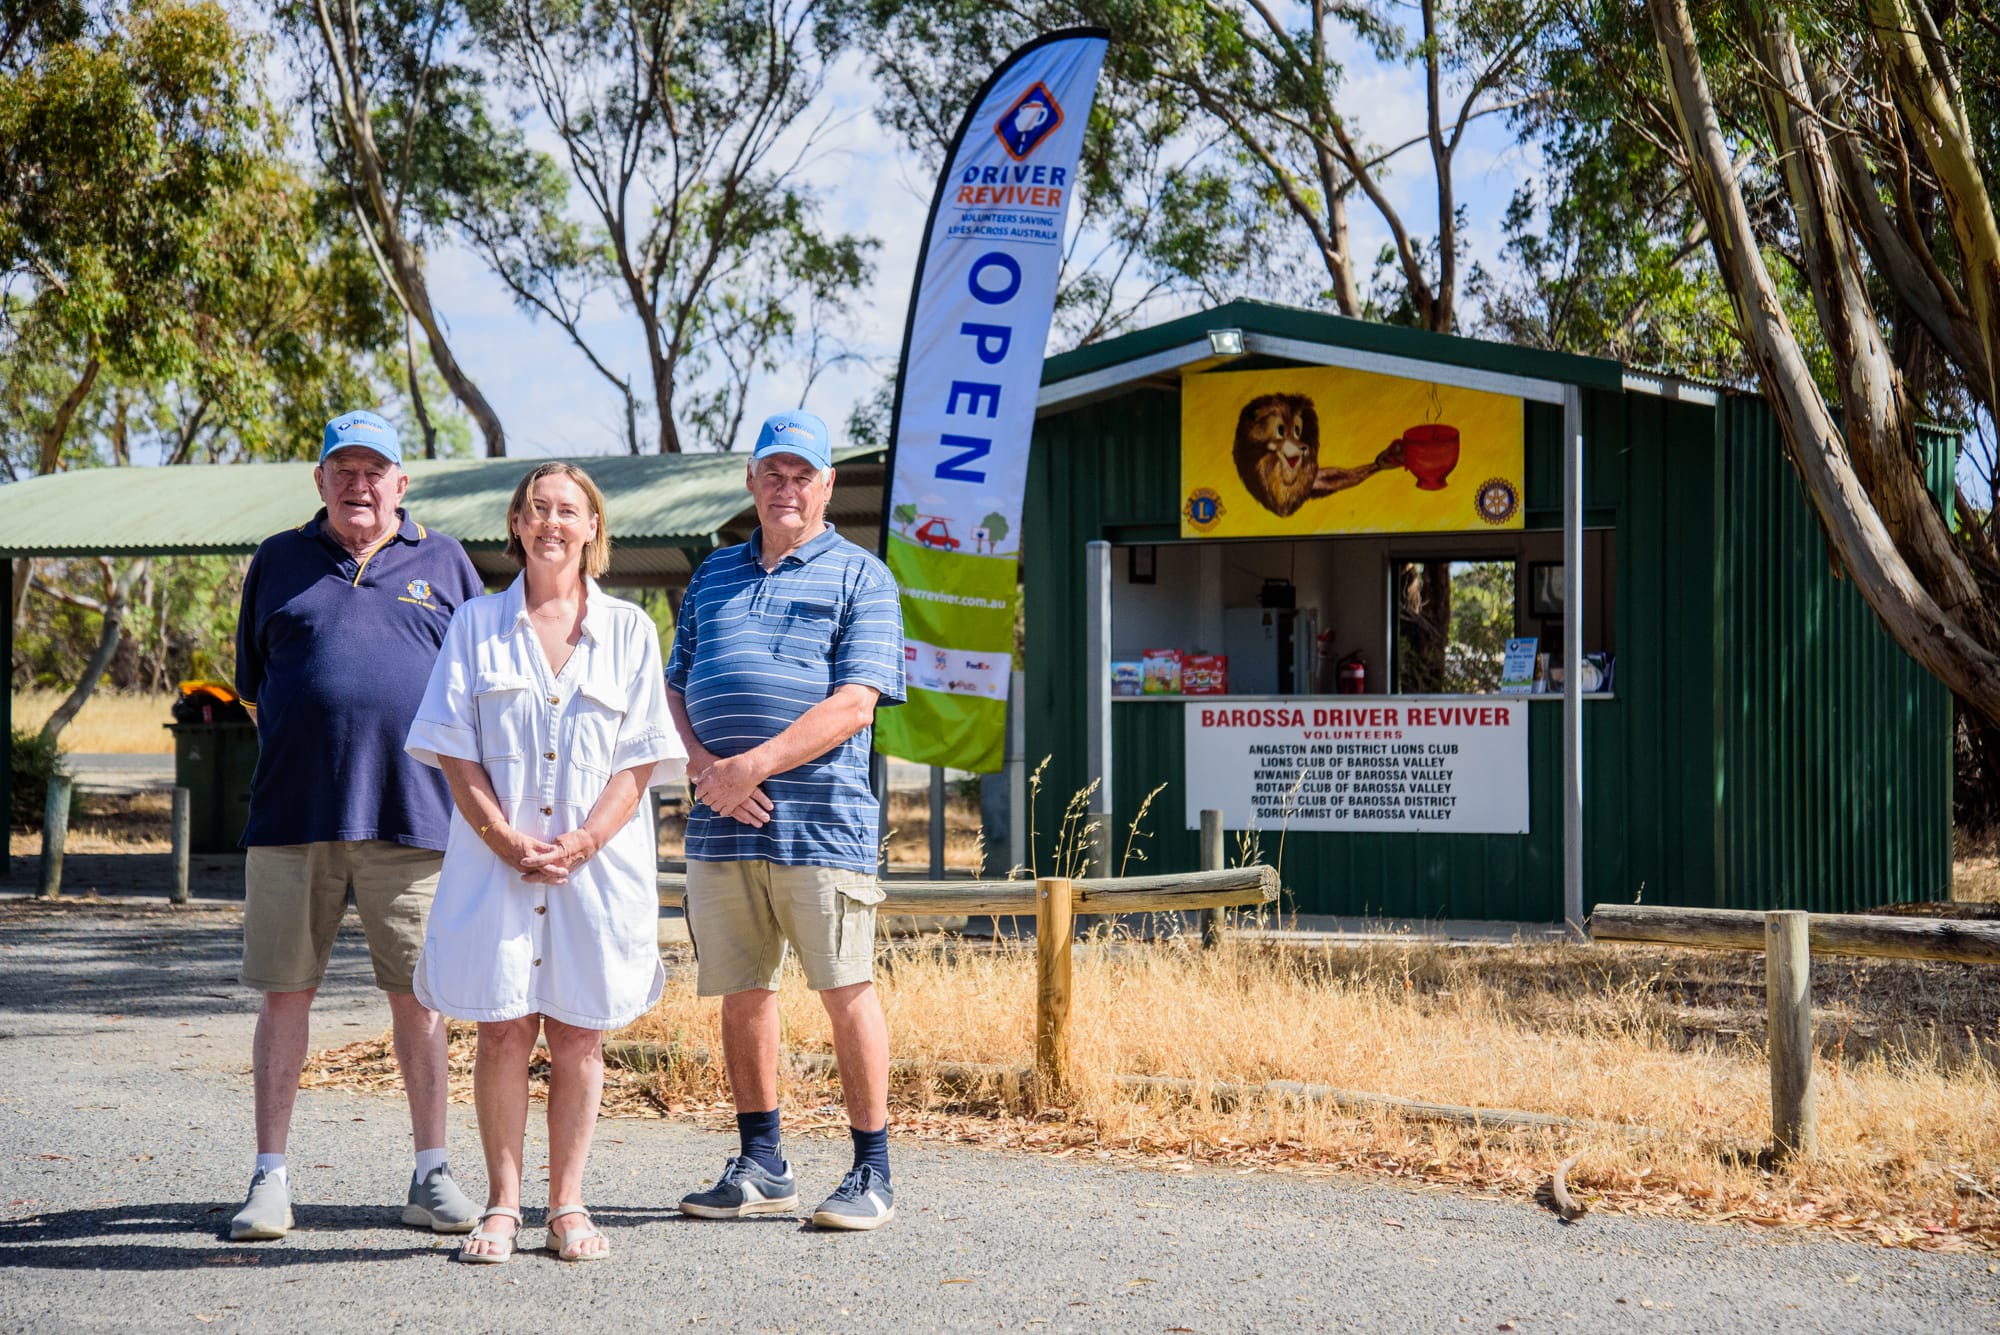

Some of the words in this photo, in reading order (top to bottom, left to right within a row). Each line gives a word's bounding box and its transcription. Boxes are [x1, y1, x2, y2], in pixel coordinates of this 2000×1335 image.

[963, 165, 1066, 186] DRIVER
[957, 185, 1062, 208] REVIVER
[962, 213, 1017, 224] VOLUNTEERS
[1019, 215, 1053, 227] SAVING
[973, 226, 1008, 236] ACROSS
[1010, 227, 1057, 240] AUSTRALA
[934, 251, 1022, 483] OPEN
[1199, 501, 1210, 520] L
[1201, 709, 1305, 728] BAROSSA
[1313, 708, 1399, 727] DRIVER
[1407, 707, 1510, 727] REVIVER
[1303, 731, 1403, 740] VOLUNTEERS
[1249, 745, 1307, 754] ANGASTON
[1310, 745, 1333, 754] AND
[1336, 744, 1387, 754] DISTRICT
[1391, 744, 1424, 754] LIONS
[1428, 744, 1458, 754] CLUB
[1261, 758, 1293, 767] LIONS
[1296, 758, 1325, 767] CLUB
[1329, 758, 1343, 767] OF
[1347, 757, 1400, 767] BAROSSA
[1403, 757, 1445, 767] VALLEY
[1254, 770, 1300, 780] KIWANIS
[1304, 770, 1333, 780] CLUB
[1337, 770, 1351, 780] OF
[1355, 770, 1408, 780] BAROSSA
[1411, 770, 1453, 780] VALLEY
[1302, 783, 1331, 793] CLUB
[1335, 783, 1350, 793] OF
[1353, 783, 1406, 793] BAROSSA
[1409, 783, 1451, 793] VALLEY
[1297, 796, 1327, 806] CLUB
[1330, 796, 1345, 806] OF
[1348, 796, 1400, 806] BAROSSA
[1404, 796, 1456, 806] DISTRICT
[1335, 808, 1350, 819] OF
[1353, 809, 1406, 819] BAROSSA
[1409, 809, 1452, 819] VALLEY
